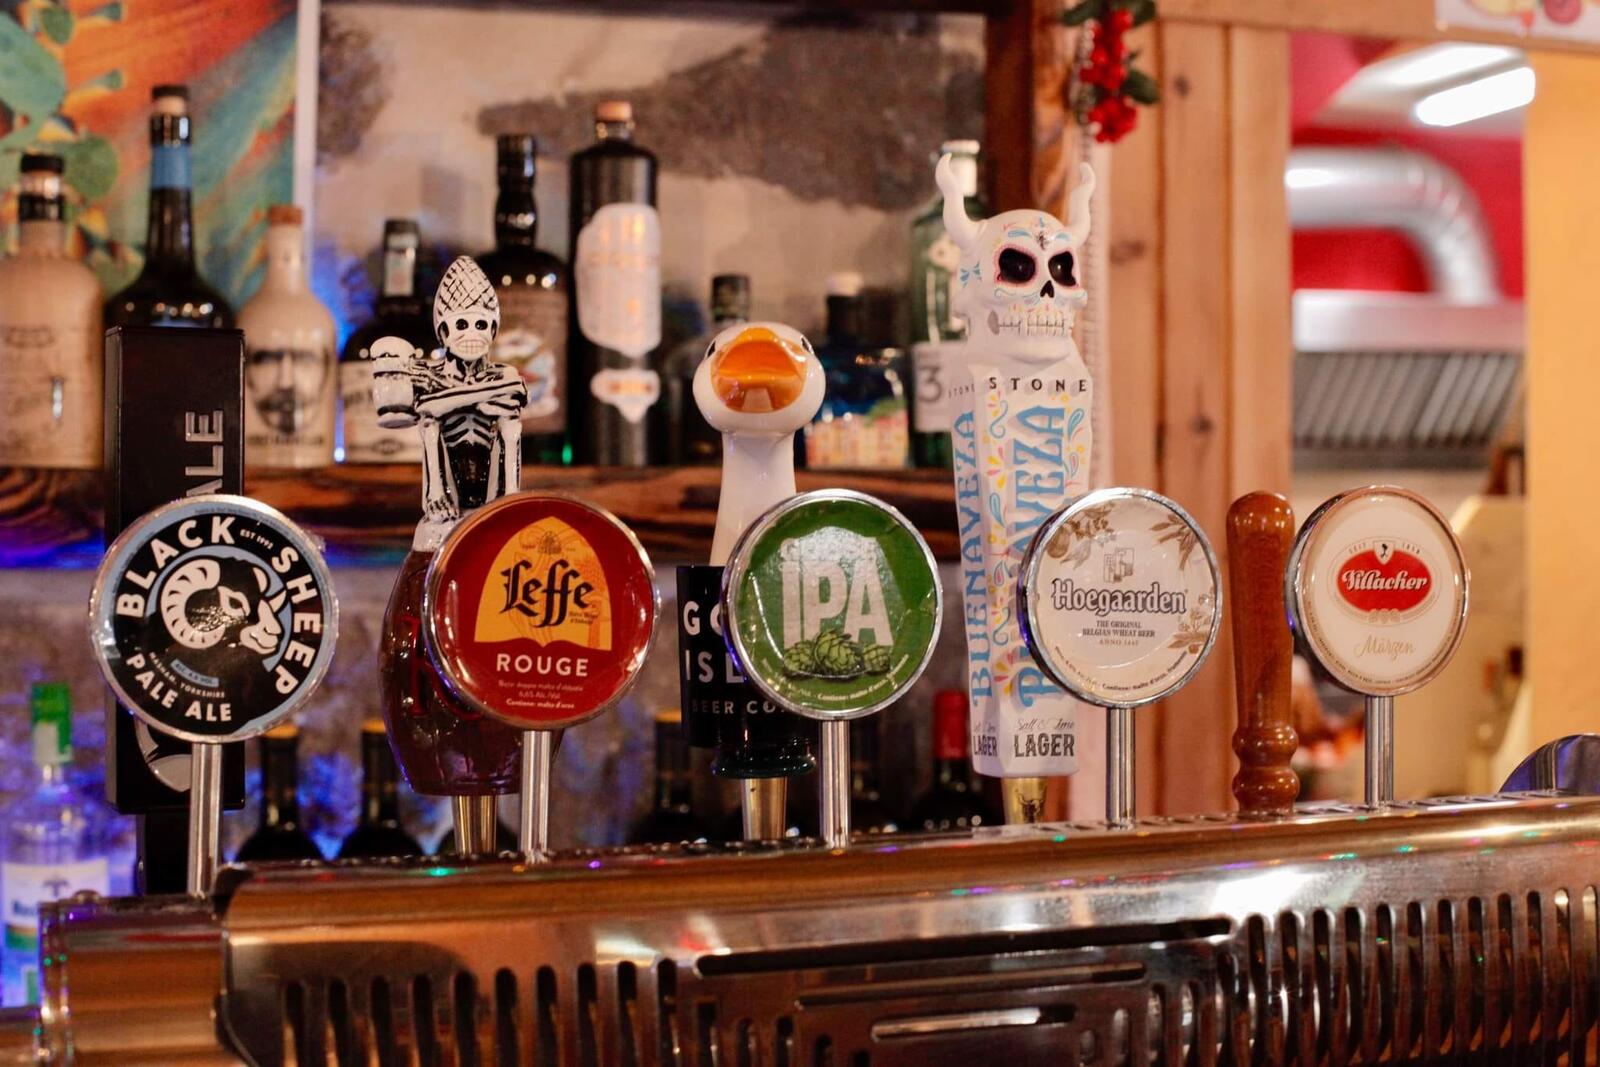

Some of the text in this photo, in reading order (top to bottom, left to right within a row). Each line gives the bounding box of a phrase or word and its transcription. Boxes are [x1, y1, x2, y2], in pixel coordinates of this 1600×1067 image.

[989, 377, 1087, 392] STONE
[240, 529, 256, 540] EST
[954, 410, 992, 707] BUENAVEZA
[1013, 405, 1065, 707] BVEZA
[779, 530, 894, 650] IPA
[1341, 569, 1428, 592] Villacher
[116, 515, 236, 619] BLACK
[271, 546, 322, 695] SHEEP
[500, 559, 594, 628] Leffe
[1051, 578, 1187, 616] Hoegaarden
[1082, 628, 1156, 638] BELGIAN WHEAT BEER
[1096, 620, 1142, 629] THE ORIGINAL
[496, 653, 589, 677] ROUGE
[685, 649, 745, 684] ISL
[126, 652, 232, 722] PALE ALE
[180, 682, 225, 699] YORKSHIRE
[973, 734, 998, 758] LAGER
[1014, 733, 1075, 757] LAGER
